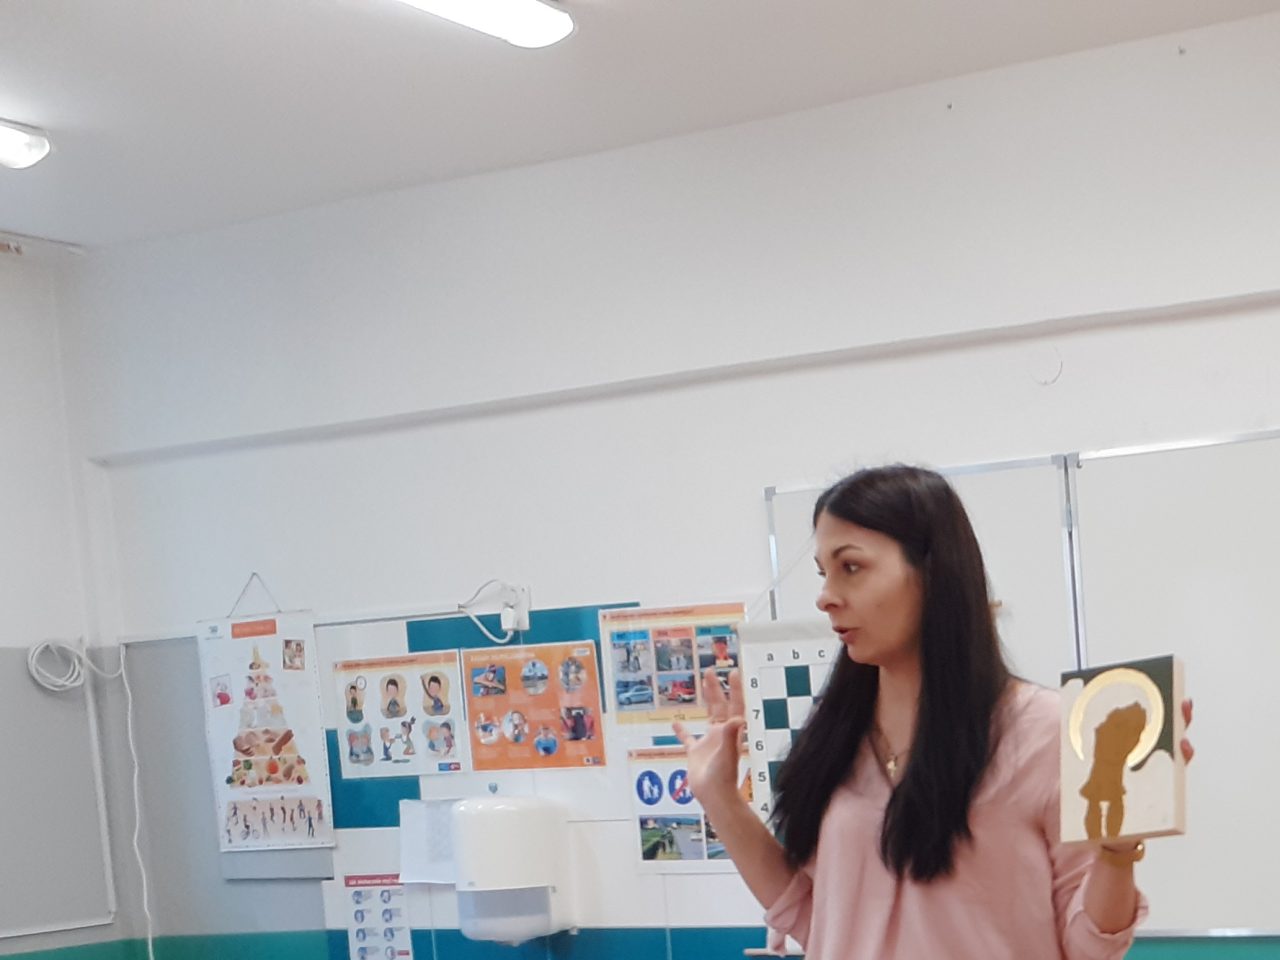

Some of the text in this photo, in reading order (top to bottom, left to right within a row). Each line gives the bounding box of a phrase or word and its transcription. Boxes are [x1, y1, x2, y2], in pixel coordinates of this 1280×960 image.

[766, 649, 825, 661] a b c
[750, 678, 758, 688] 8
[752, 709, 760, 719] 7
[755, 740, 764, 751] 6
[758, 772, 767, 782] 5
[760, 802, 769, 812] 4
